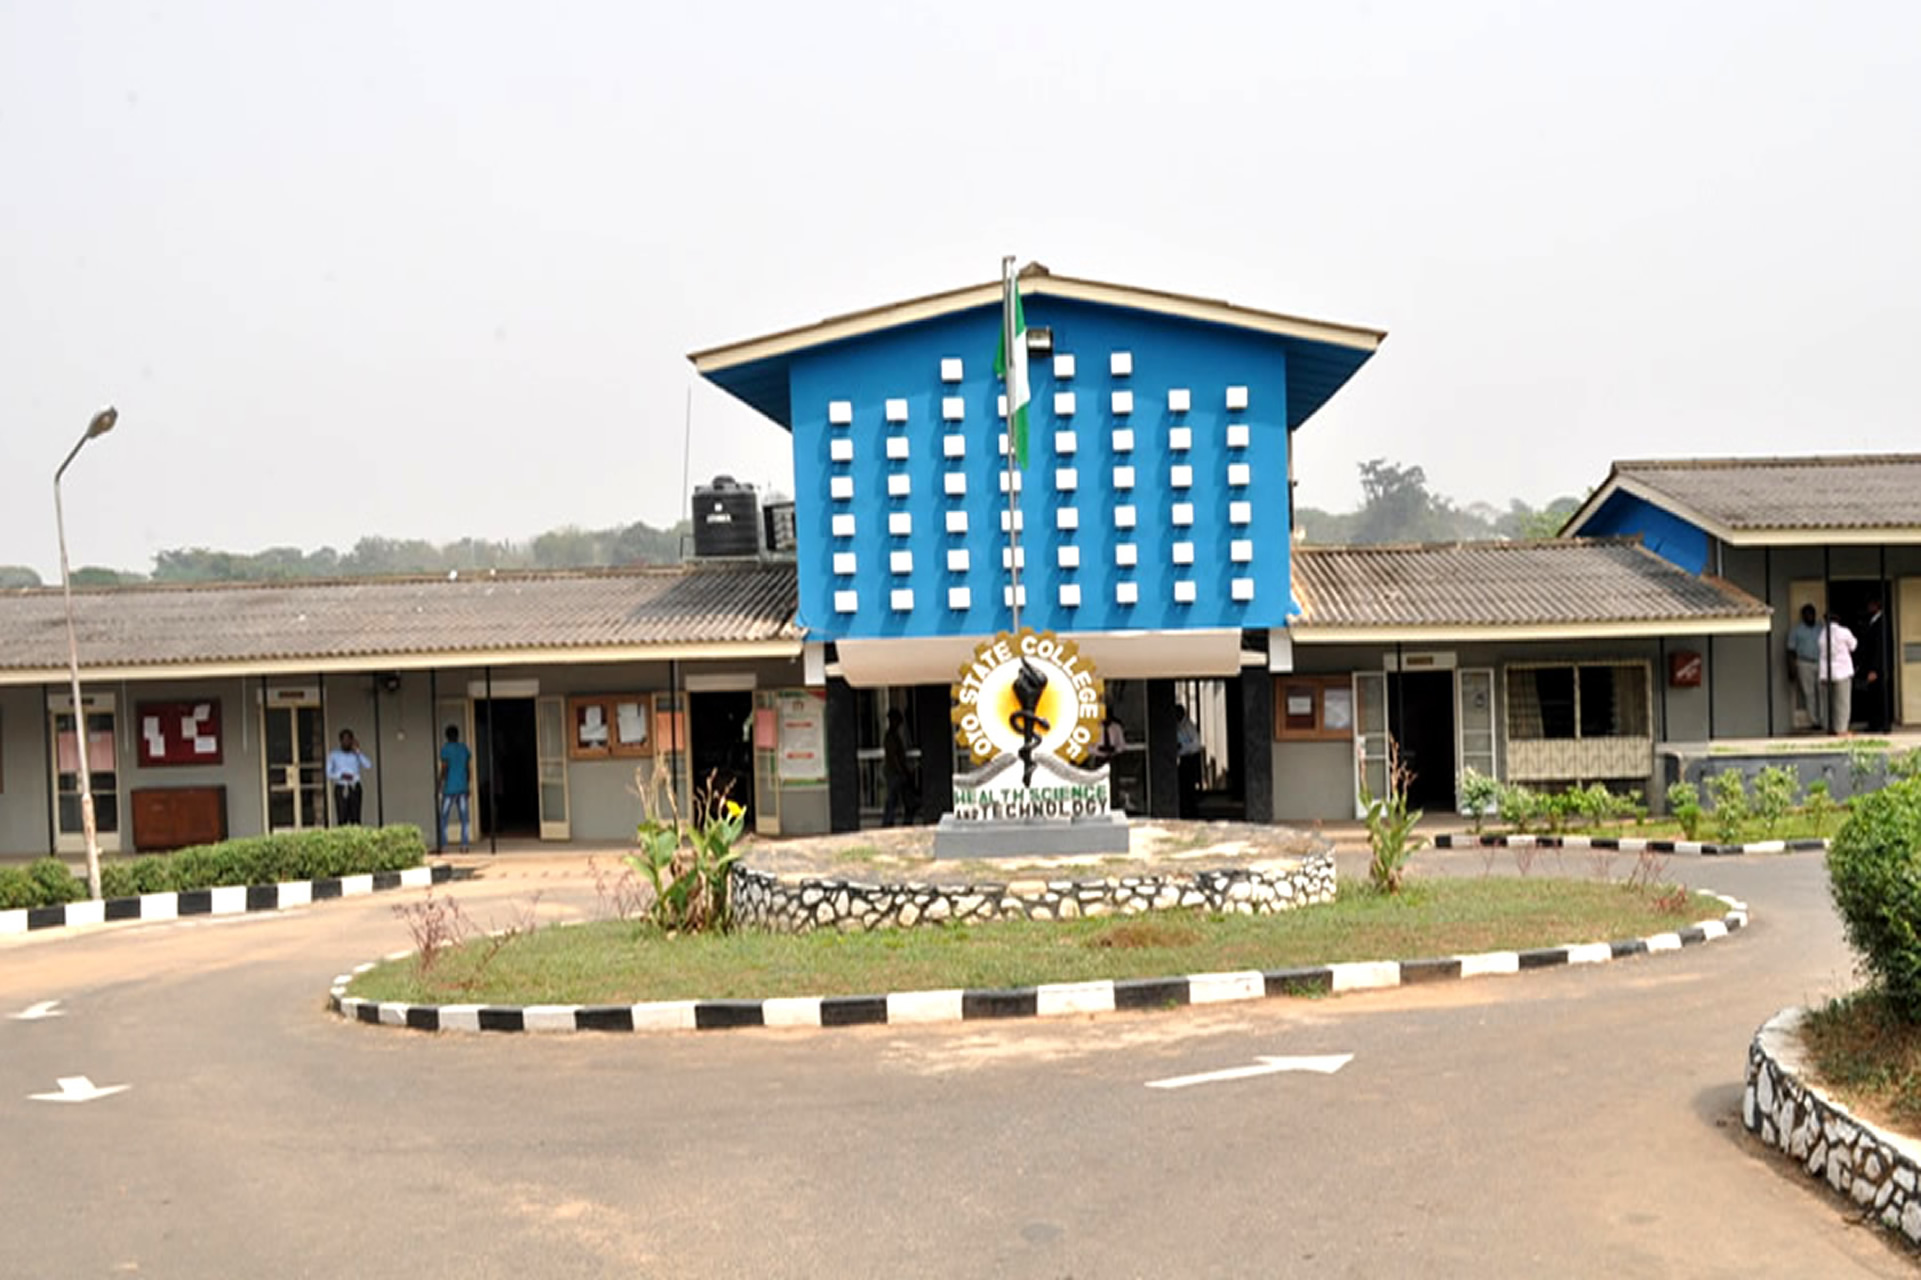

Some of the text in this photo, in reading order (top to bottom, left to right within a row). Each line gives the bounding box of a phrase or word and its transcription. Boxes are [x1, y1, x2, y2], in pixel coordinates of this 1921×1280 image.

[959, 636, 1098, 760] OYO STATE COLLEGE OF
[953, 785, 1107, 805] HEALTH SCIENCE
[956, 799, 1108, 820] AND TECHNOLOGY
